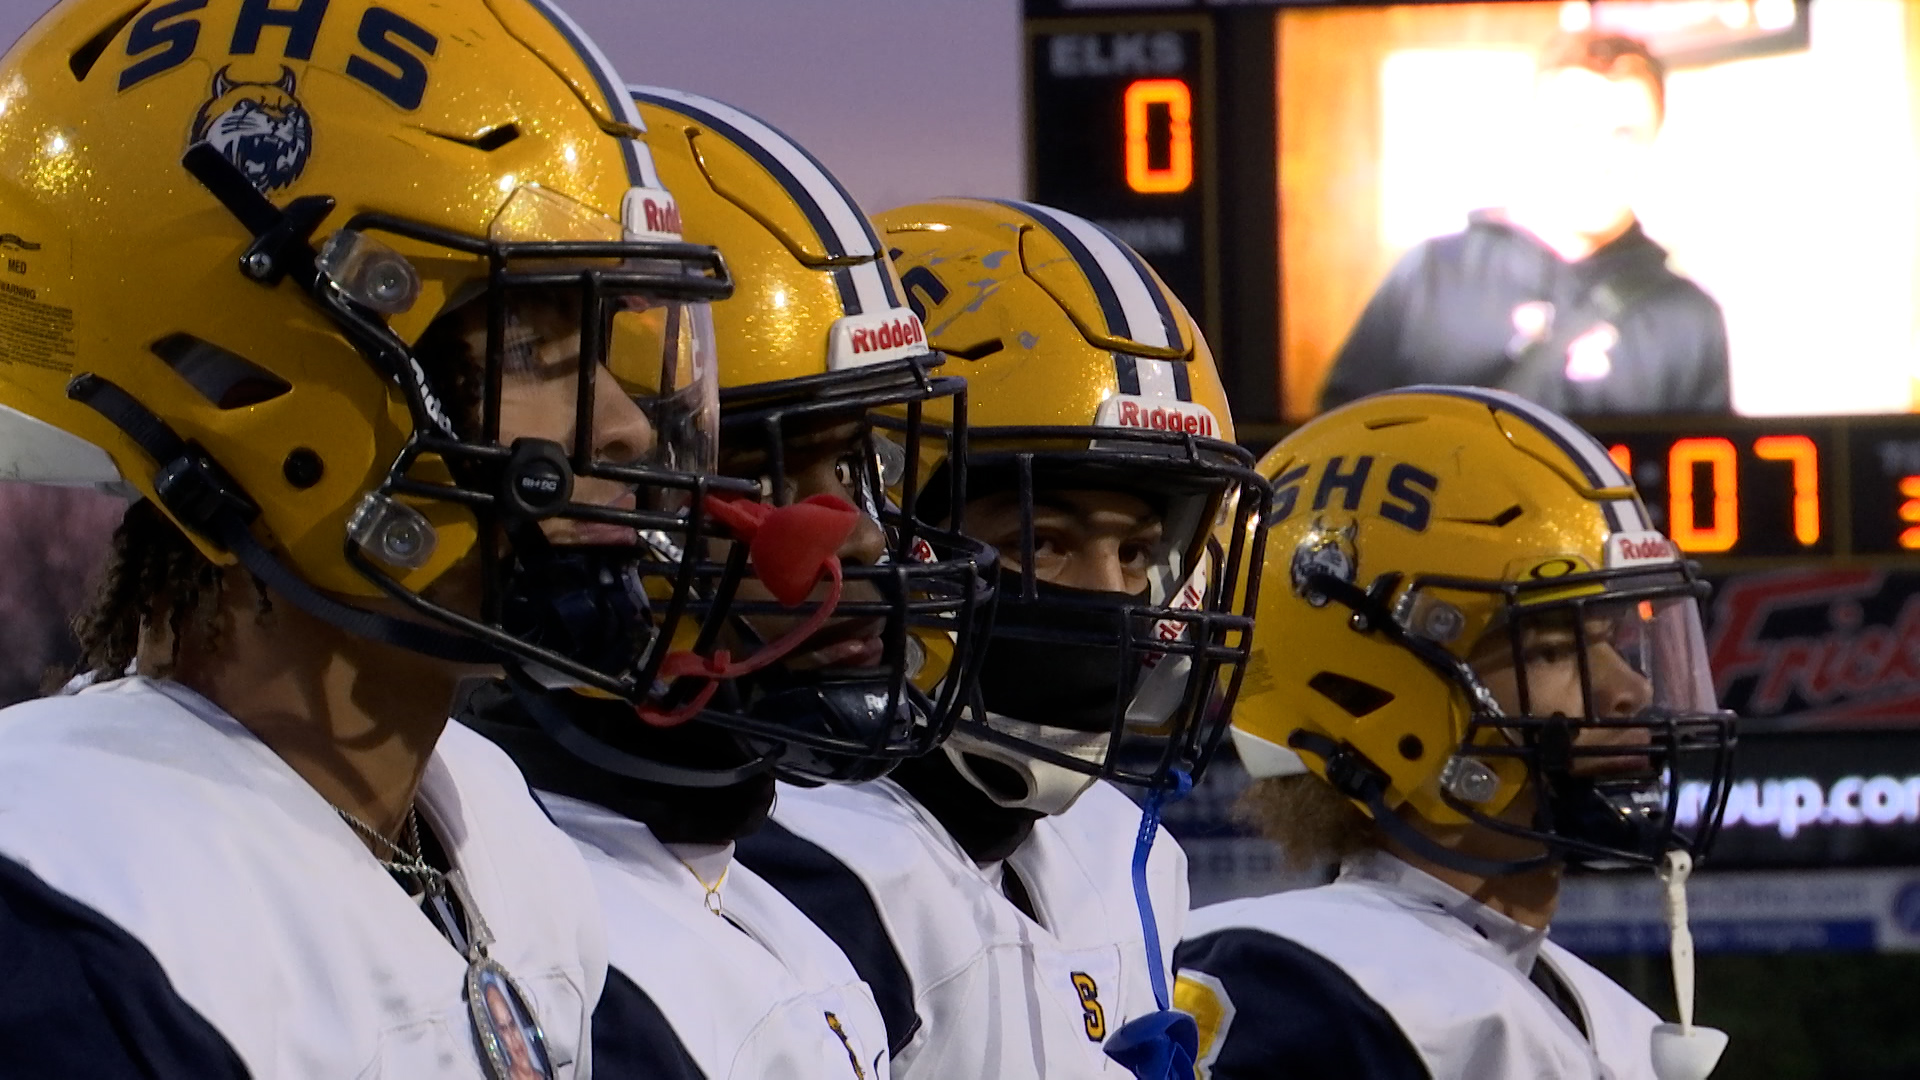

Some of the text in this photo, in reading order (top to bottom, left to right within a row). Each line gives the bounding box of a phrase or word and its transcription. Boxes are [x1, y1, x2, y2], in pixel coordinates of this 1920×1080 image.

[117, 0, 439, 111] SHS
[1051, 32, 1184, 76] ELKS
[1124, 79, 1192, 194] 0
[852, 315, 923, 354] Riddell
[1119, 400, 1213, 436] Riddell
[1266, 456, 1438, 532] SHS
